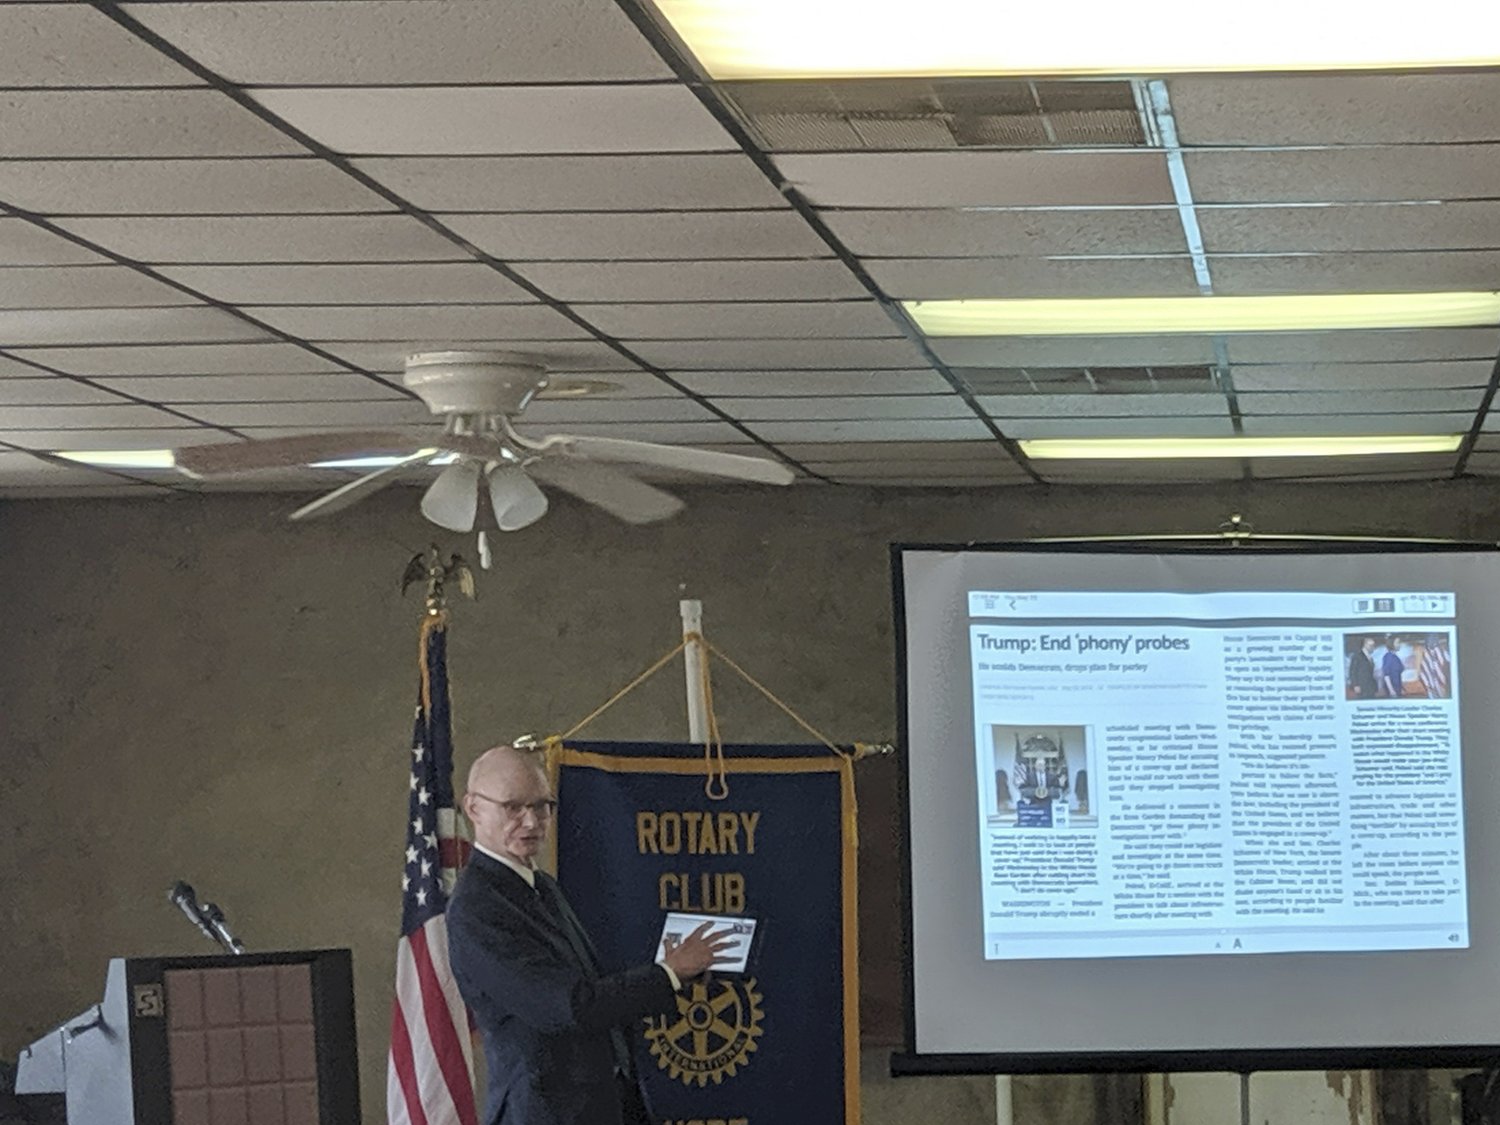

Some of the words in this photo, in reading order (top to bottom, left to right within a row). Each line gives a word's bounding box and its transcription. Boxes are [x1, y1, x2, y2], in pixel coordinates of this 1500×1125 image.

[977, 633, 1037, 654] Trump:
[1040, 634, 1071, 651] End
[1074, 633, 1133, 654] 'phony'
[1135, 634, 1190, 654] probes
[1108, 662, 1121, 671] for
[636, 811, 761, 855] ROTARY
[658, 872, 746, 914] CLUB
[1233, 938, 1242, 949] A
